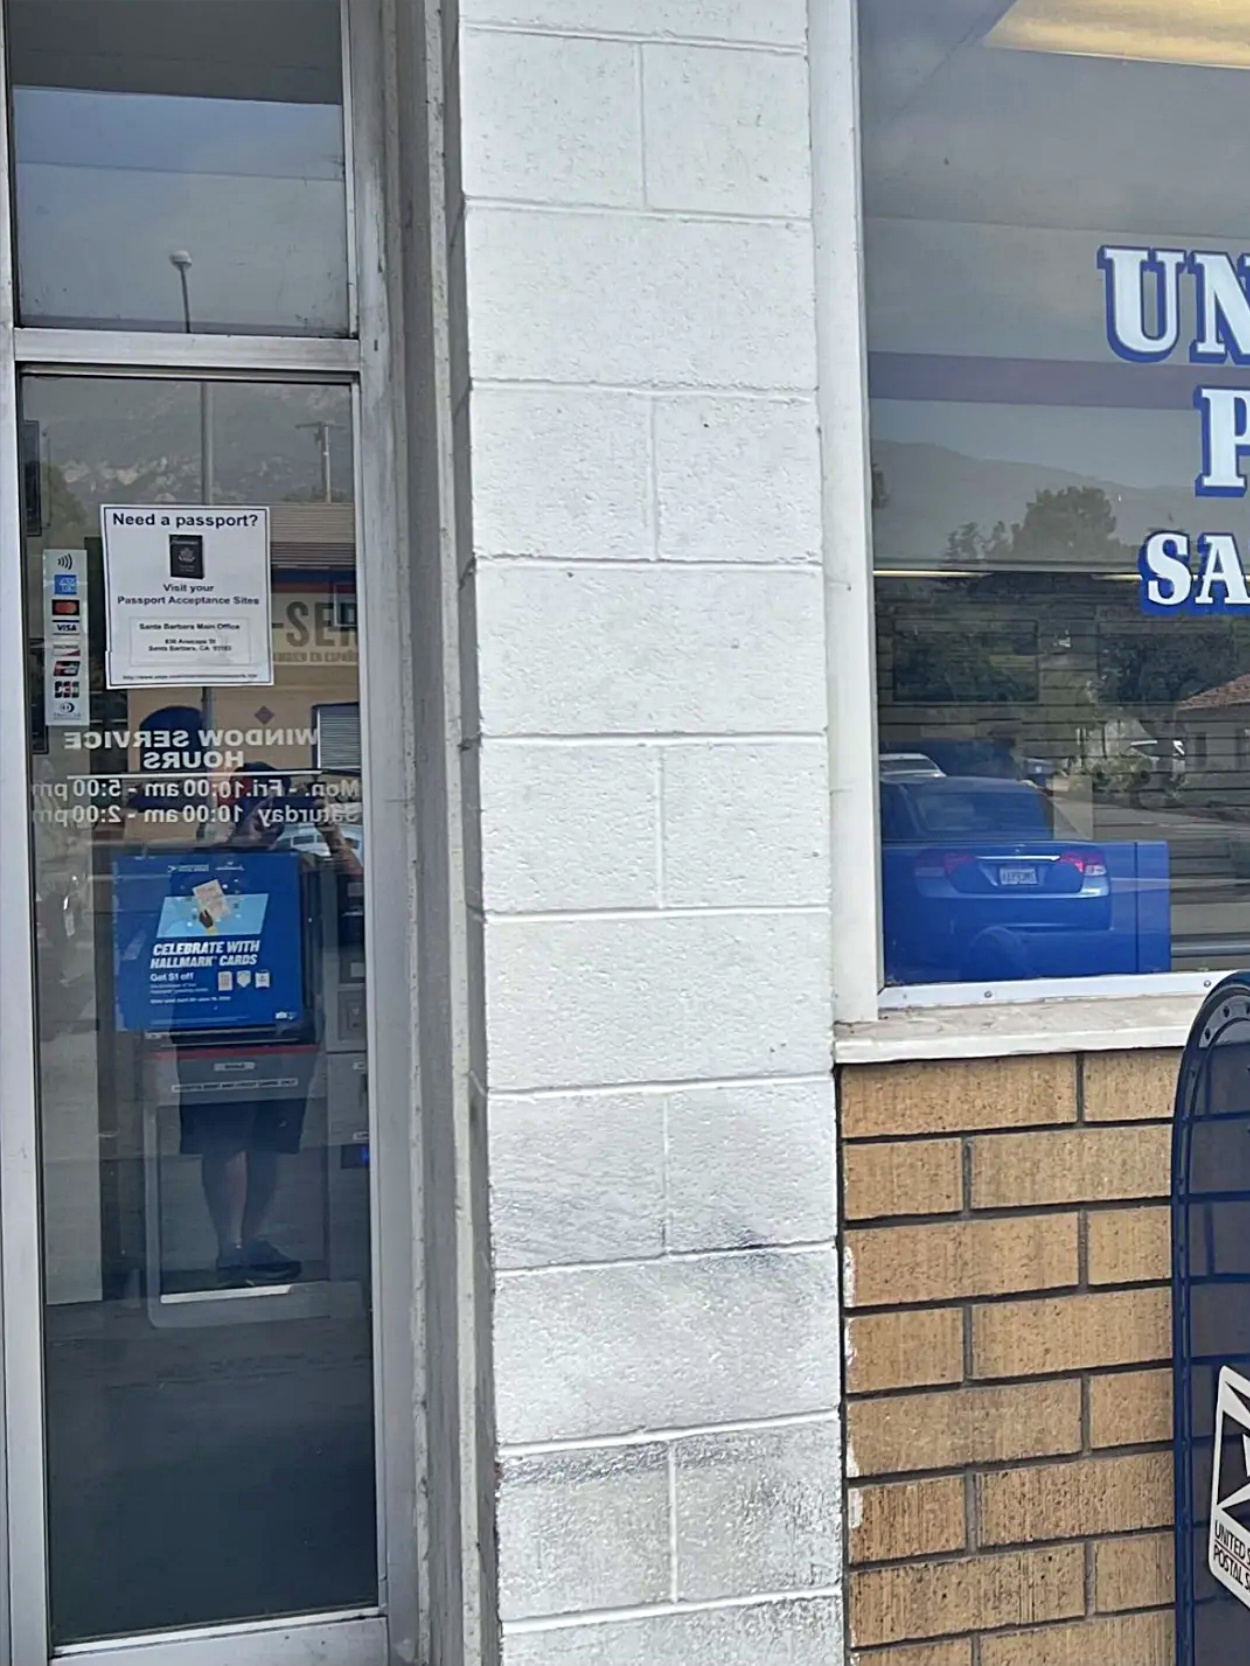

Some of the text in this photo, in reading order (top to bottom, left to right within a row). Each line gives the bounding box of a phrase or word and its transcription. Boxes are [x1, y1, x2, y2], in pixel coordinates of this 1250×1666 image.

[113, 513, 258, 529] Need a passport?
[163, 584, 214, 594] Visit your
[117, 596, 260, 606] Passport Acceptance Sites
[153, 940, 261, 956] CELEBRATE WITH
[219, 954, 258, 966] CARDS
[150, 972, 194, 982] Get $1 off
[1214, 1519, 1245, 1559] UNITED
[1213, 1545, 1243, 1585] POSTAL
